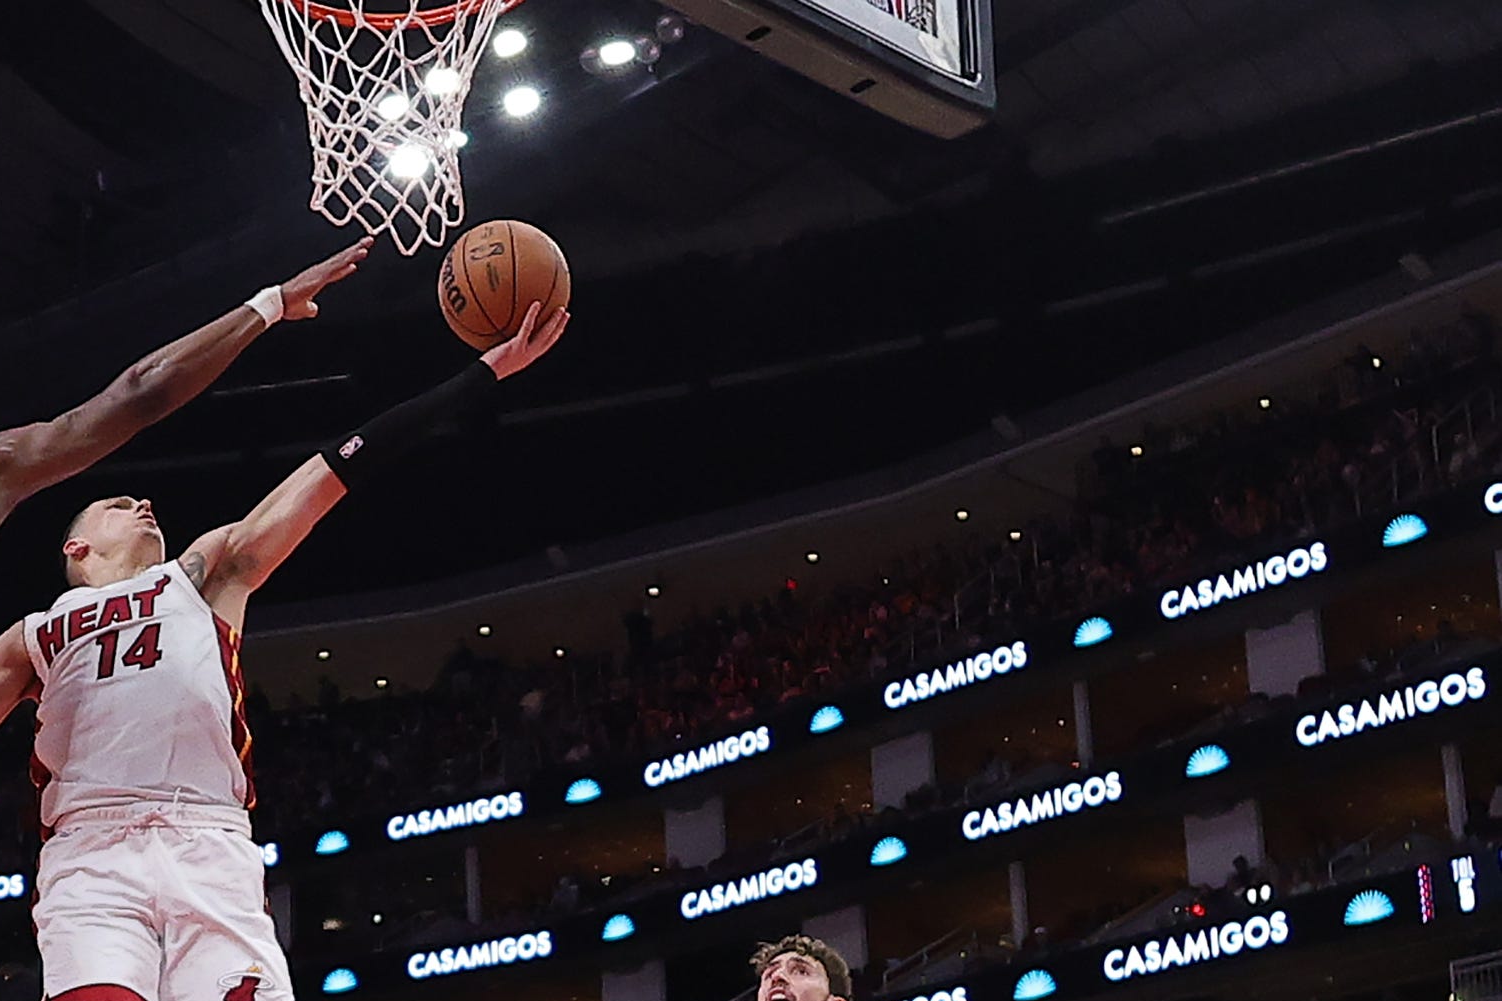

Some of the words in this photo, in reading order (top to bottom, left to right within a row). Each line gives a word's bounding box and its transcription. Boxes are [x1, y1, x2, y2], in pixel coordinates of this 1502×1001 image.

[1162, 544, 1327, 618] CASAMIGOS
[36, 573, 172, 668] HEAT
[96, 622, 163, 680] 14
[886, 643, 1027, 708] CASAMIGOS
[1298, 669, 1486, 746] CASAMIGOS
[646, 728, 770, 786] CASAMIGOS
[389, 793, 523, 839] CASAMIGOS
[964, 773, 1122, 839] CASAMIGOS
[682, 860, 817, 918] CASAMIGOS
[409, 932, 552, 978] CASAMIGOS
[1105, 910, 1289, 980] CASAMIGOS
